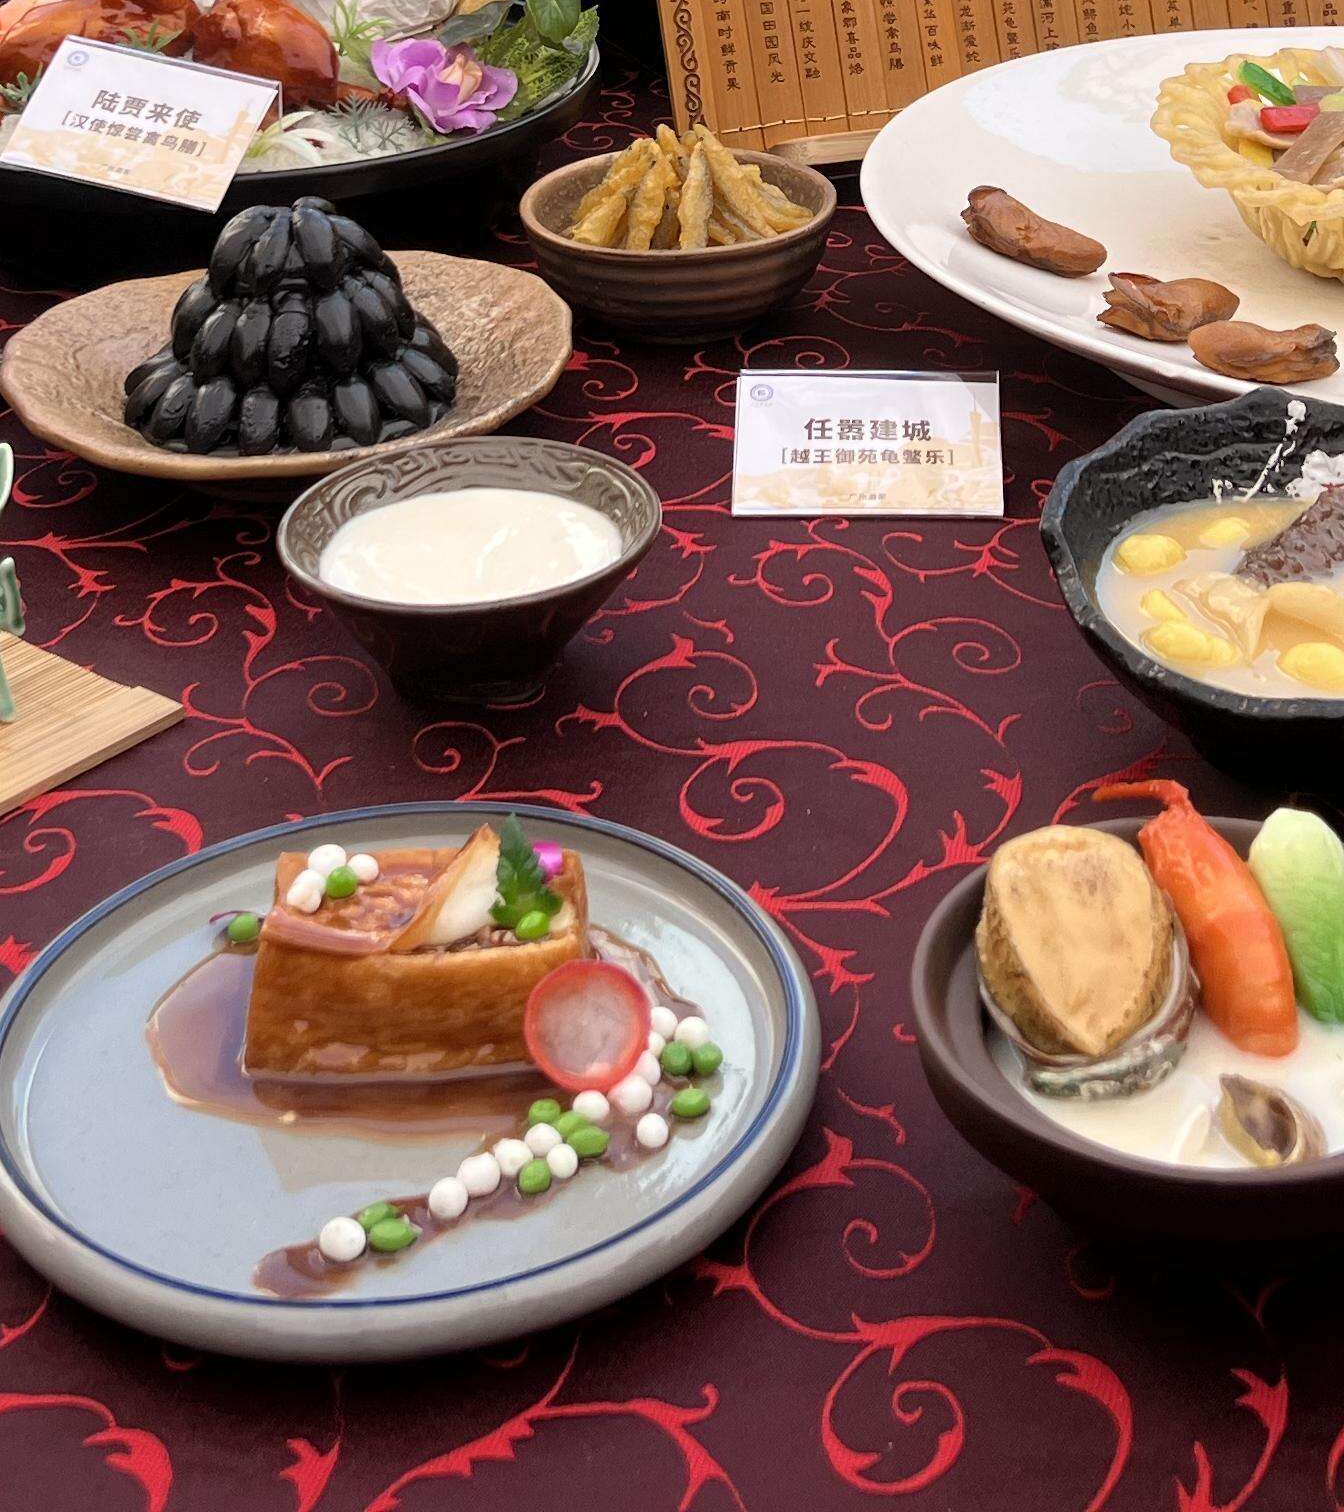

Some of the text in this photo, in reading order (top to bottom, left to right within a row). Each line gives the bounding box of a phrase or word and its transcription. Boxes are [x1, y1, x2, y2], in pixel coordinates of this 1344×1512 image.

[90, 89, 204, 133] 陆贾来使
[802, 417, 934, 442] 任嚣建城
